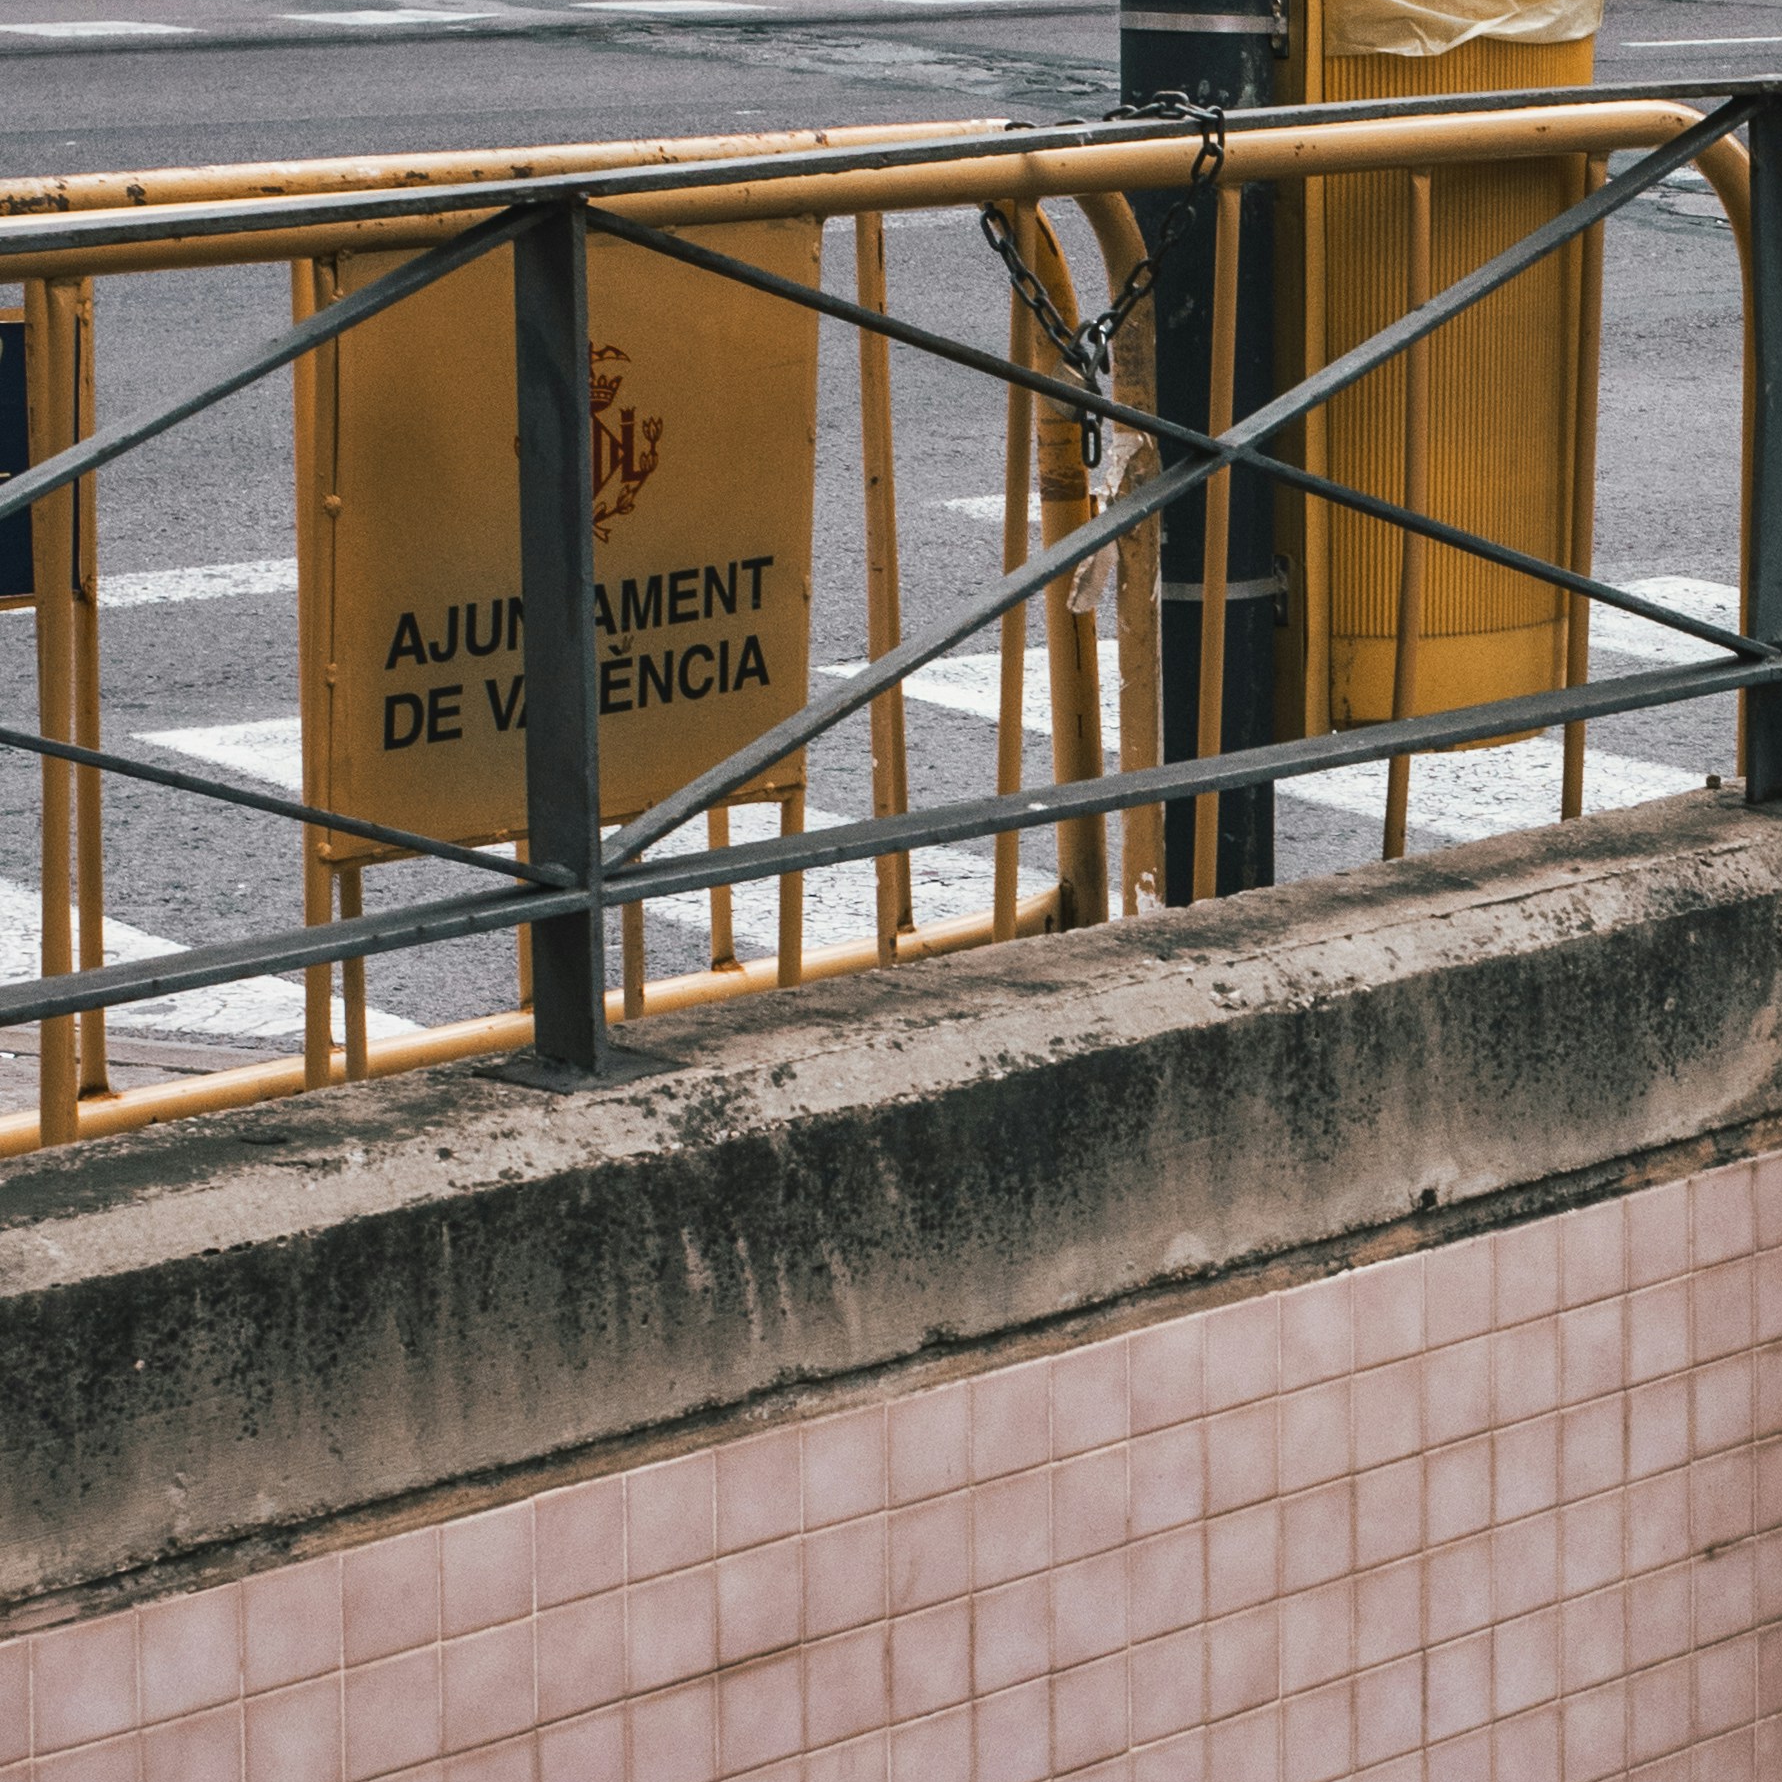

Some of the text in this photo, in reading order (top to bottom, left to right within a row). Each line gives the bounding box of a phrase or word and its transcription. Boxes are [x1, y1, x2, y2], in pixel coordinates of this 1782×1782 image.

[384, 555, 774, 671] AJUNAMENT
[383, 634, 772, 752] DE VÈNCIA
